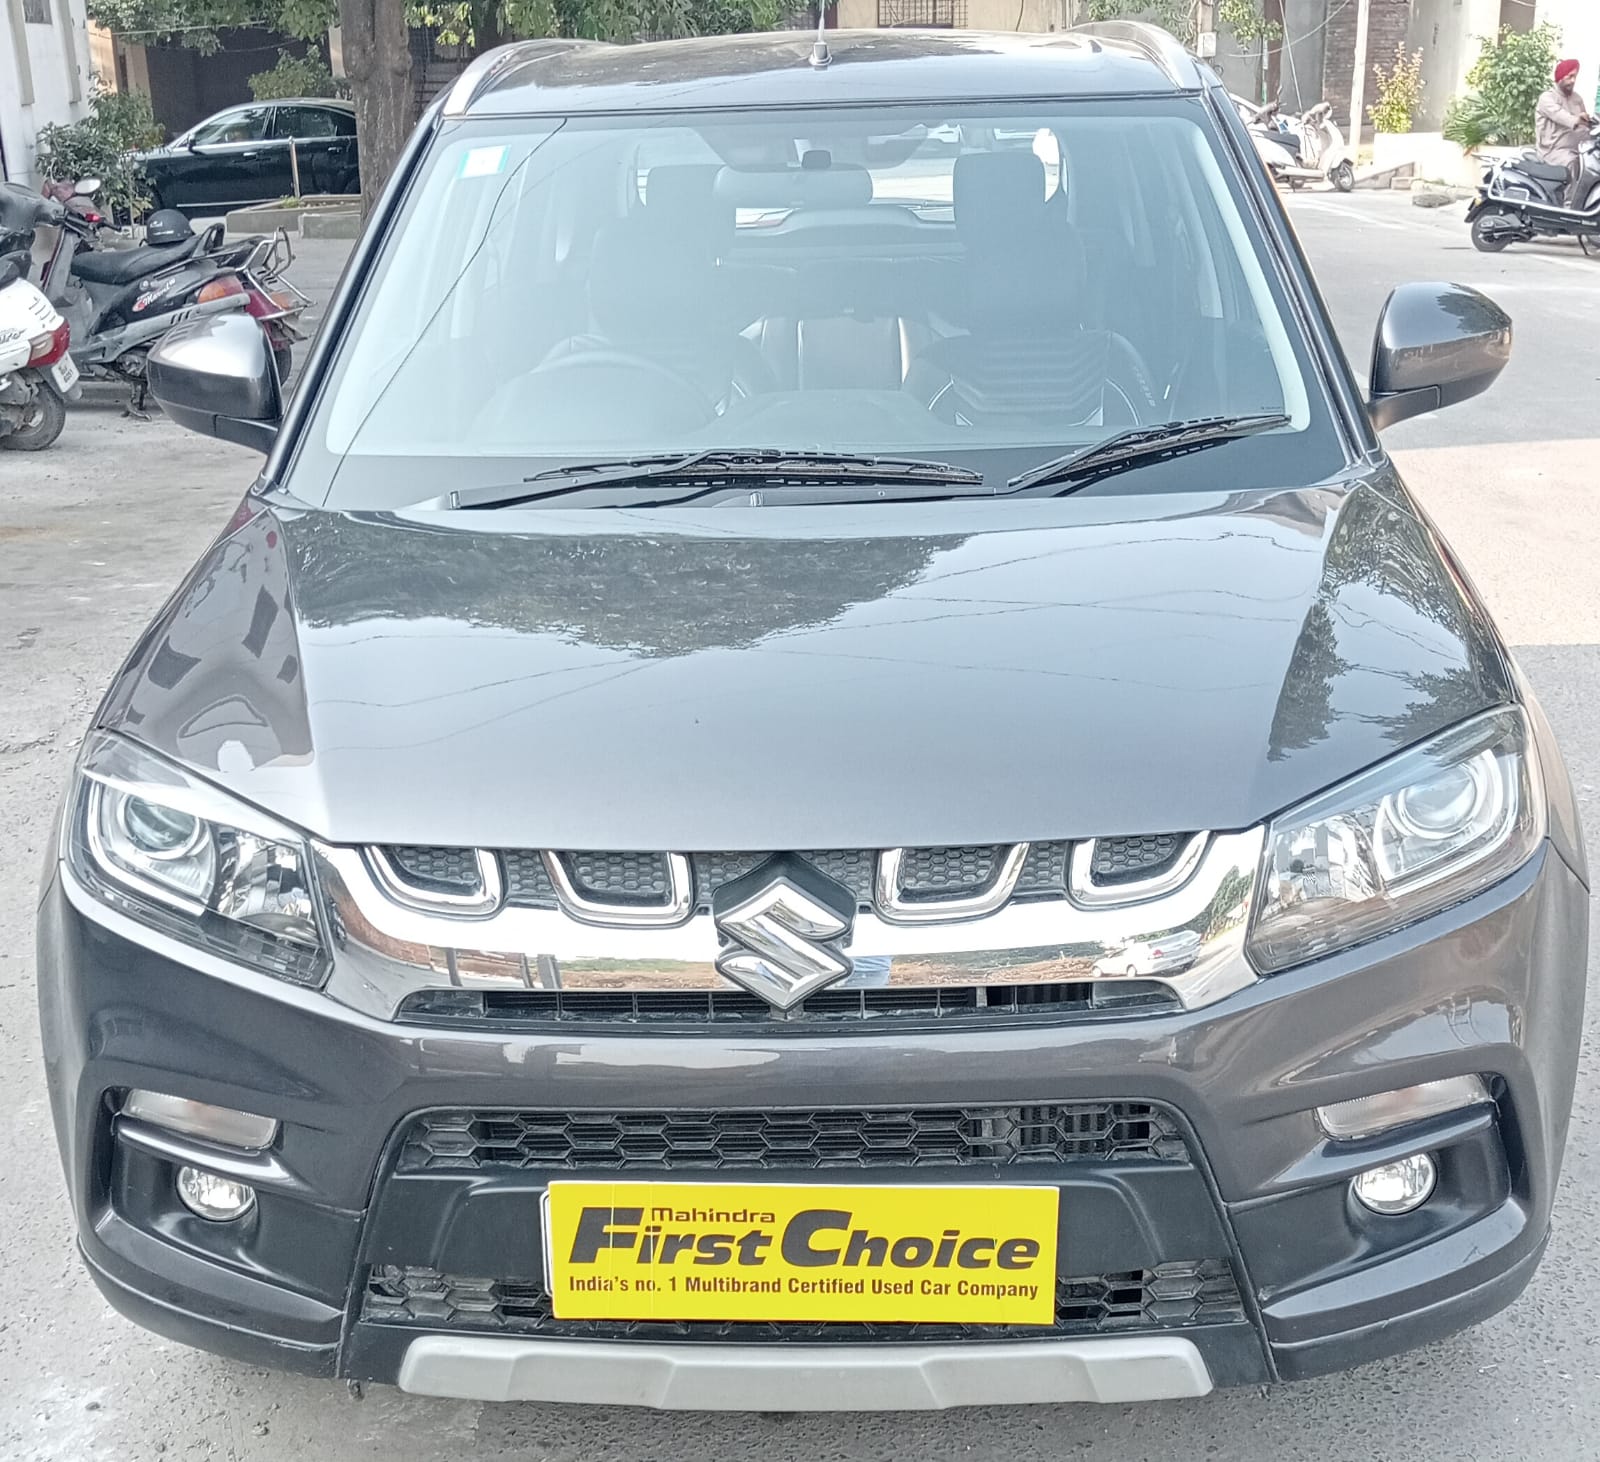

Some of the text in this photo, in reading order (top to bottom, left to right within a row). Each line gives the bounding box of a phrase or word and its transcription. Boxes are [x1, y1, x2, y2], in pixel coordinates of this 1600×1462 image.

[651, 1207, 776, 1223] Mahindra
[568, 1206, 1041, 1270] First Choice
[569, 1275, 1038, 1301] India's no. 1 Multibrand Certified Used Car Company
